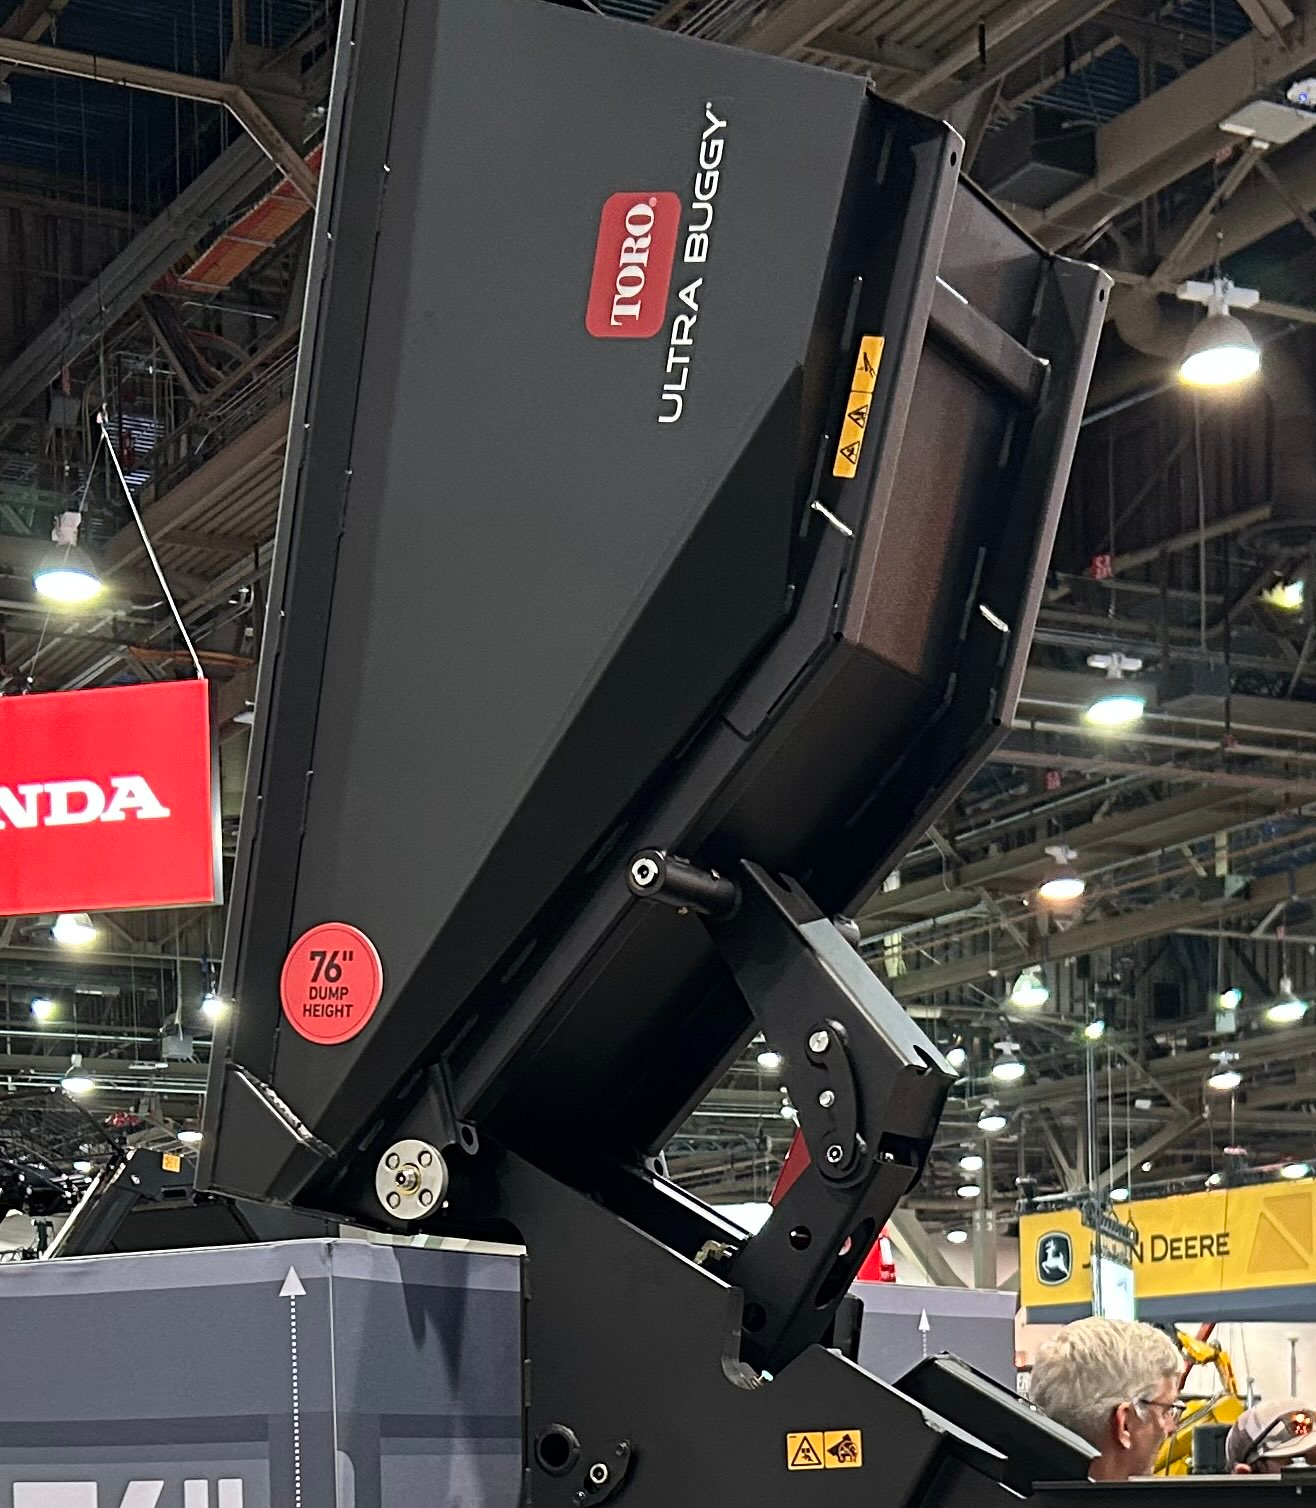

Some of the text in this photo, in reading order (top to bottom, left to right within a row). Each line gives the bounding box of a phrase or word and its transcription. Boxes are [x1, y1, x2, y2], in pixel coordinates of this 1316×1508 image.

[610, 203, 654, 327] TORO
[658, 109, 727, 423] ULTRA BUGGY
[309, 950, 354, 983] 76"
[309, 986, 349, 1001] DUMP
[302, 1004, 353, 1018] HEIGHT
[1151, 1232, 1230, 1262] DEERE
